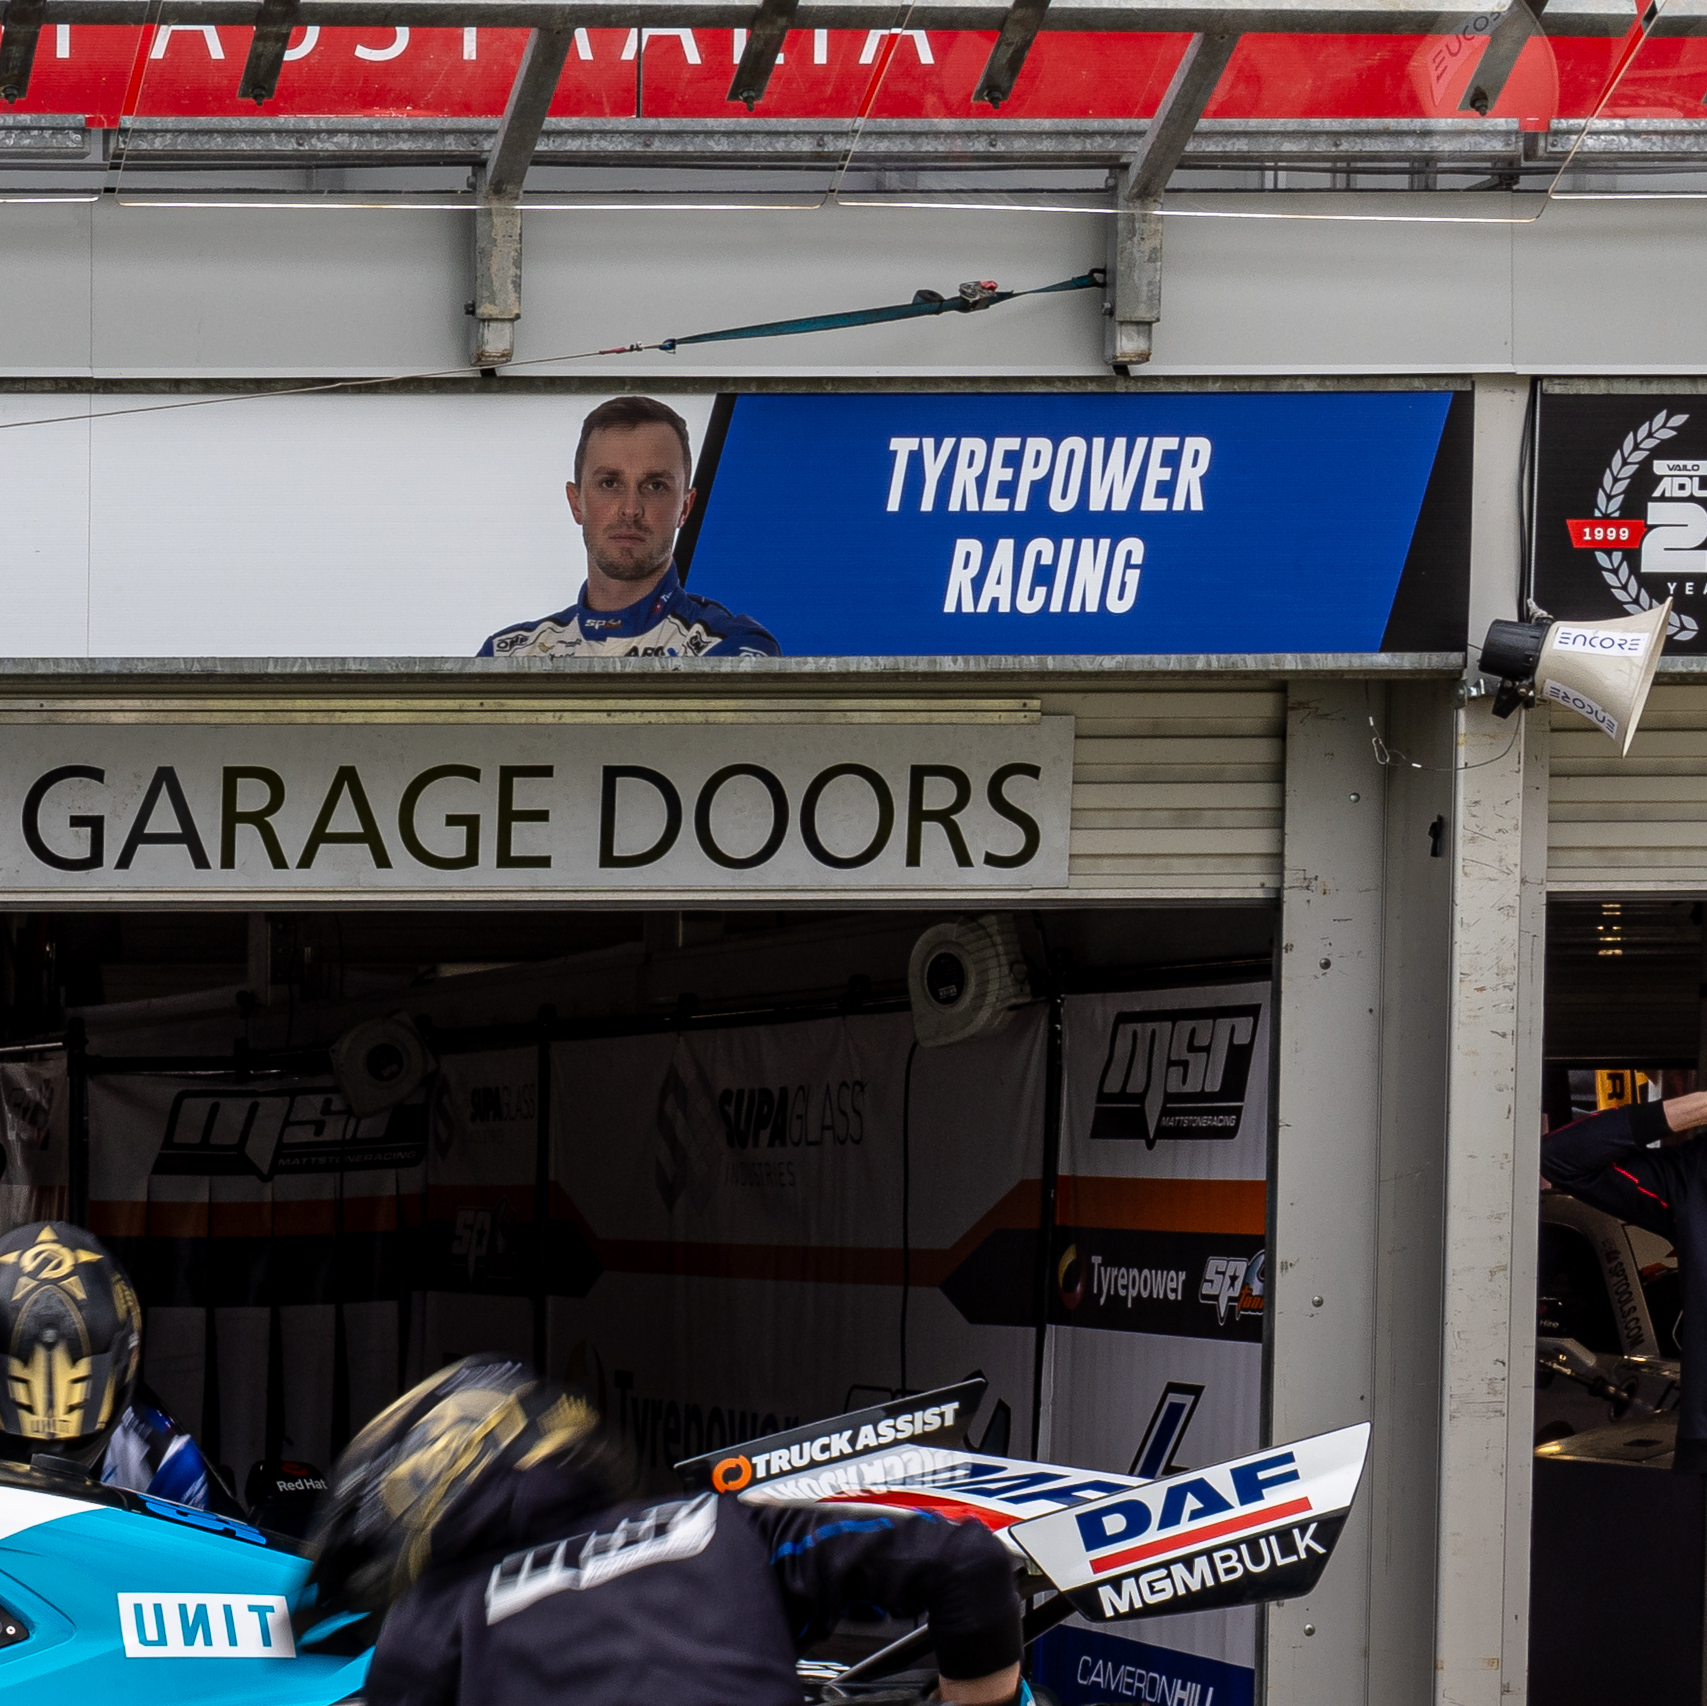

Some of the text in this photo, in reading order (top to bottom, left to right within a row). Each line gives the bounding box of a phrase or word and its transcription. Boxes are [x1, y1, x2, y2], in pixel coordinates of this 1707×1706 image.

[886, 437, 1214, 513] TYREPOWER
[1667, 464, 1700, 472] VAILO
[1583, 528, 1630, 541] 1999
[944, 537, 1145, 614] RACING
[1557, 631, 1643, 651] ENCORE
[21, 764, 554, 873] GARAGE
[598, 762, 1042, 870] DOORS
[720, 1080, 865, 1149] SUPAGLASS
[1091, 1254, 1187, 1309] Tyrepower
[1075, 1451, 1300, 1551] DAF
[1097, 1523, 1327, 1618] MGMBULK
